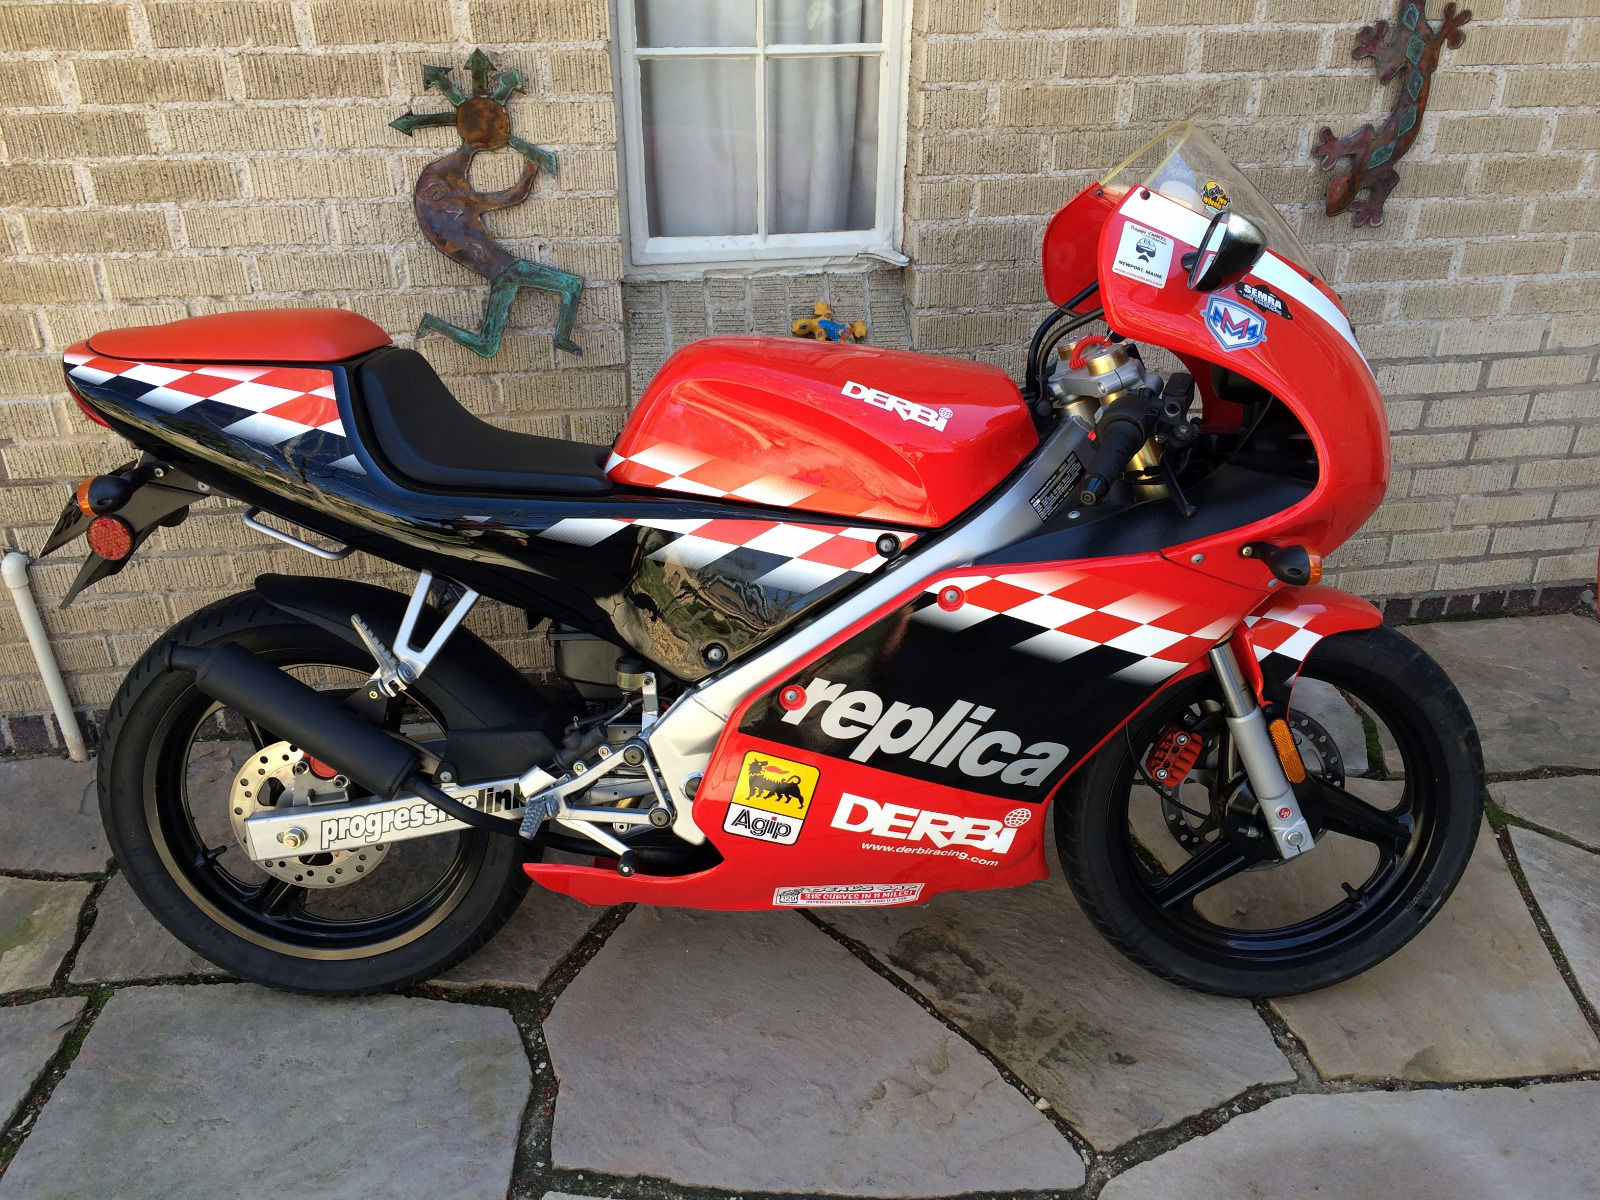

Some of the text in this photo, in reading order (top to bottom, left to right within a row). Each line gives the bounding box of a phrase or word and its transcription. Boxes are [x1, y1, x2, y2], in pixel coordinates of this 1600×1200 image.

[1145, 269, 1163, 280] MAINE
[781, 677, 1070, 787] replica
[731, 808, 792, 840] Agip
[861, 842, 999, 867] www.derbiracing.com
[822, 892, 860, 901] CURVES
[882, 890, 913, 899] MILES!
